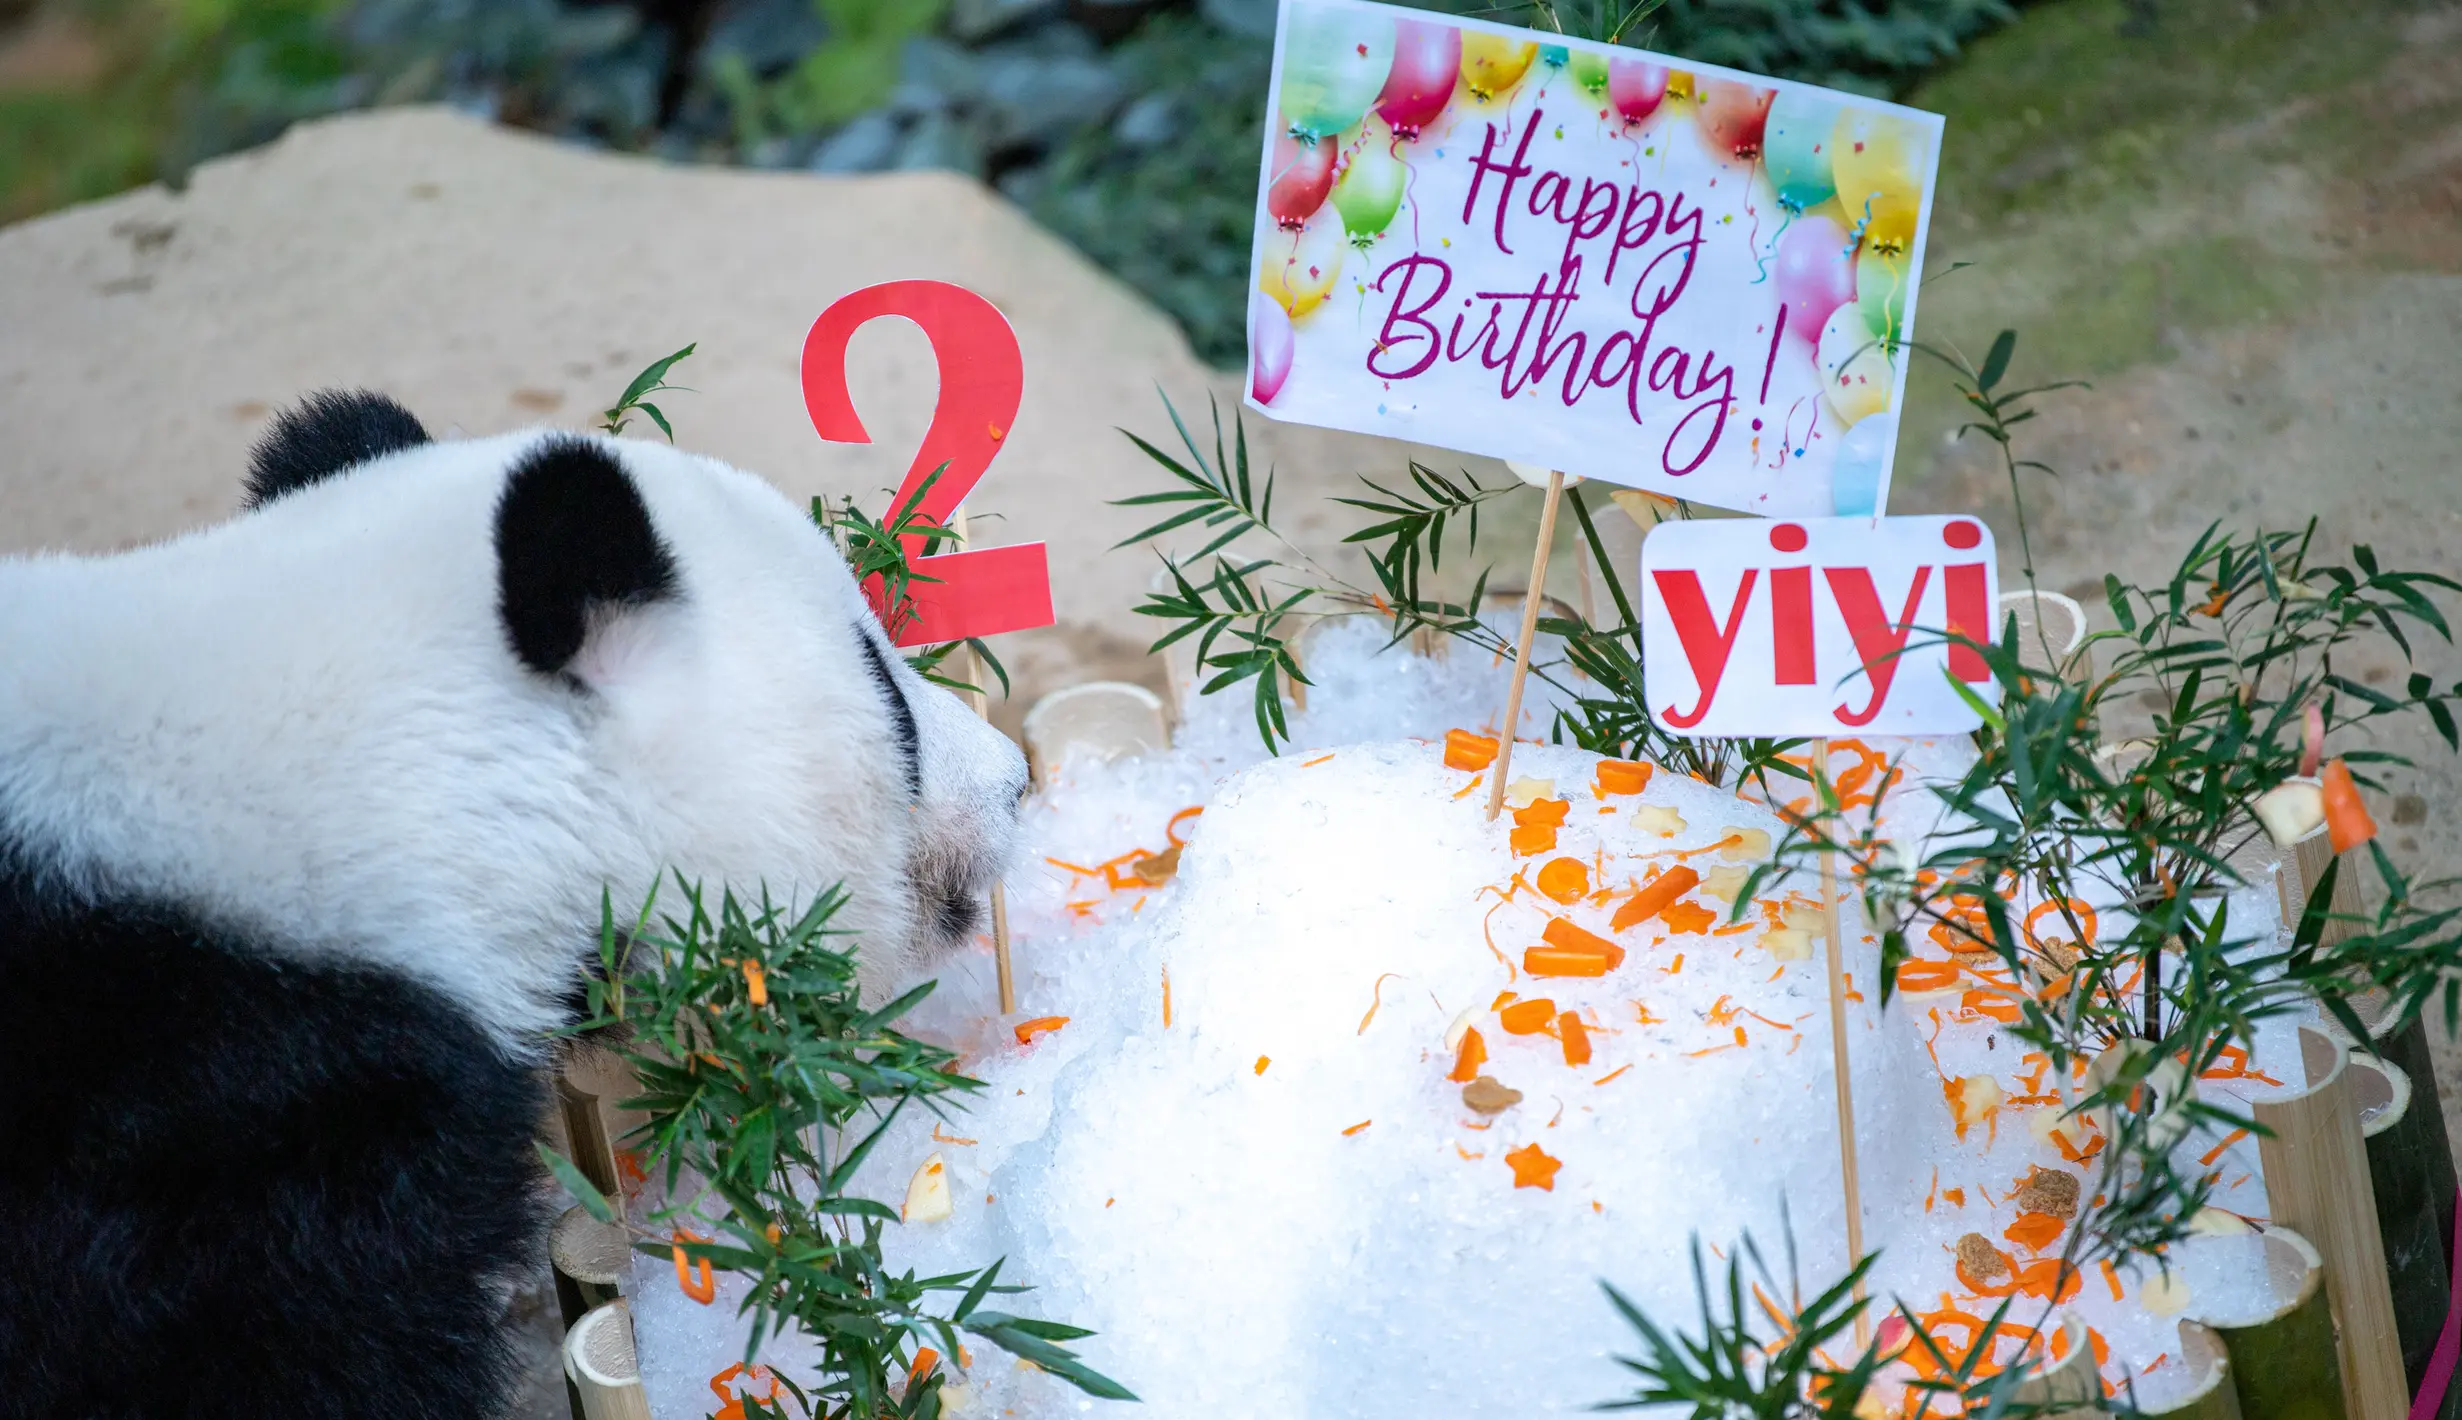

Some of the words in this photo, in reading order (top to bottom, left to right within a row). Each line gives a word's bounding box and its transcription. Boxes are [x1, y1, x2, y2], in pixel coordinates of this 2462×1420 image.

[1462, 109, 1707, 320] Happy
[801, 279, 1056, 648] 2
[1366, 252, 1788, 476] Birthday!
[1651, 520, 1991, 728] yiyi
